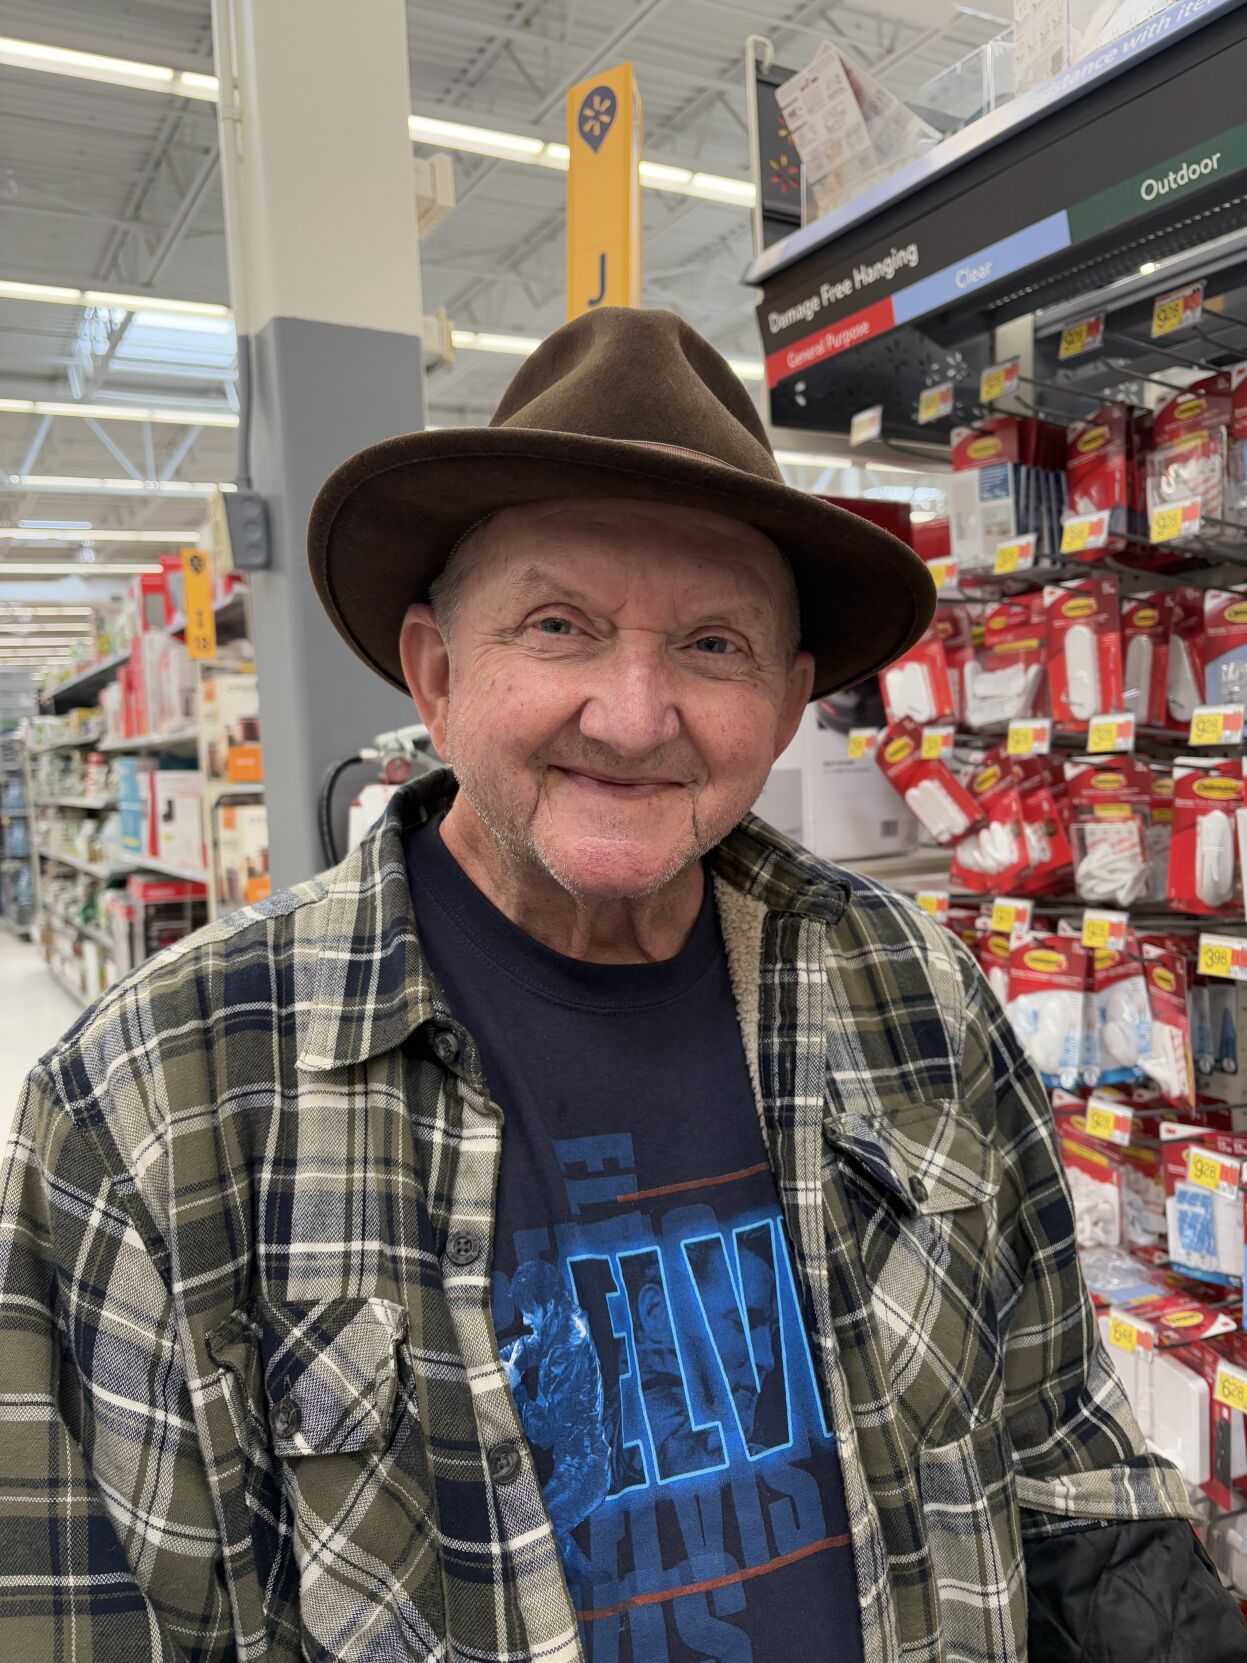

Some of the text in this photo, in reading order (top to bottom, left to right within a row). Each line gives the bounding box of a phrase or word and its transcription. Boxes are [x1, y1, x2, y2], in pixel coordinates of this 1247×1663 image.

[1123, 14, 1171, 53] with
[1140, 152, 1221, 201] Outdoor
[588, 253, 607, 305] J
[768, 242, 919, 334] Damage Free Hanging
[955, 260, 993, 289] Clear
[786, 319, 870, 368] General Purpose
[566, 1215, 834, 1501] ELV
